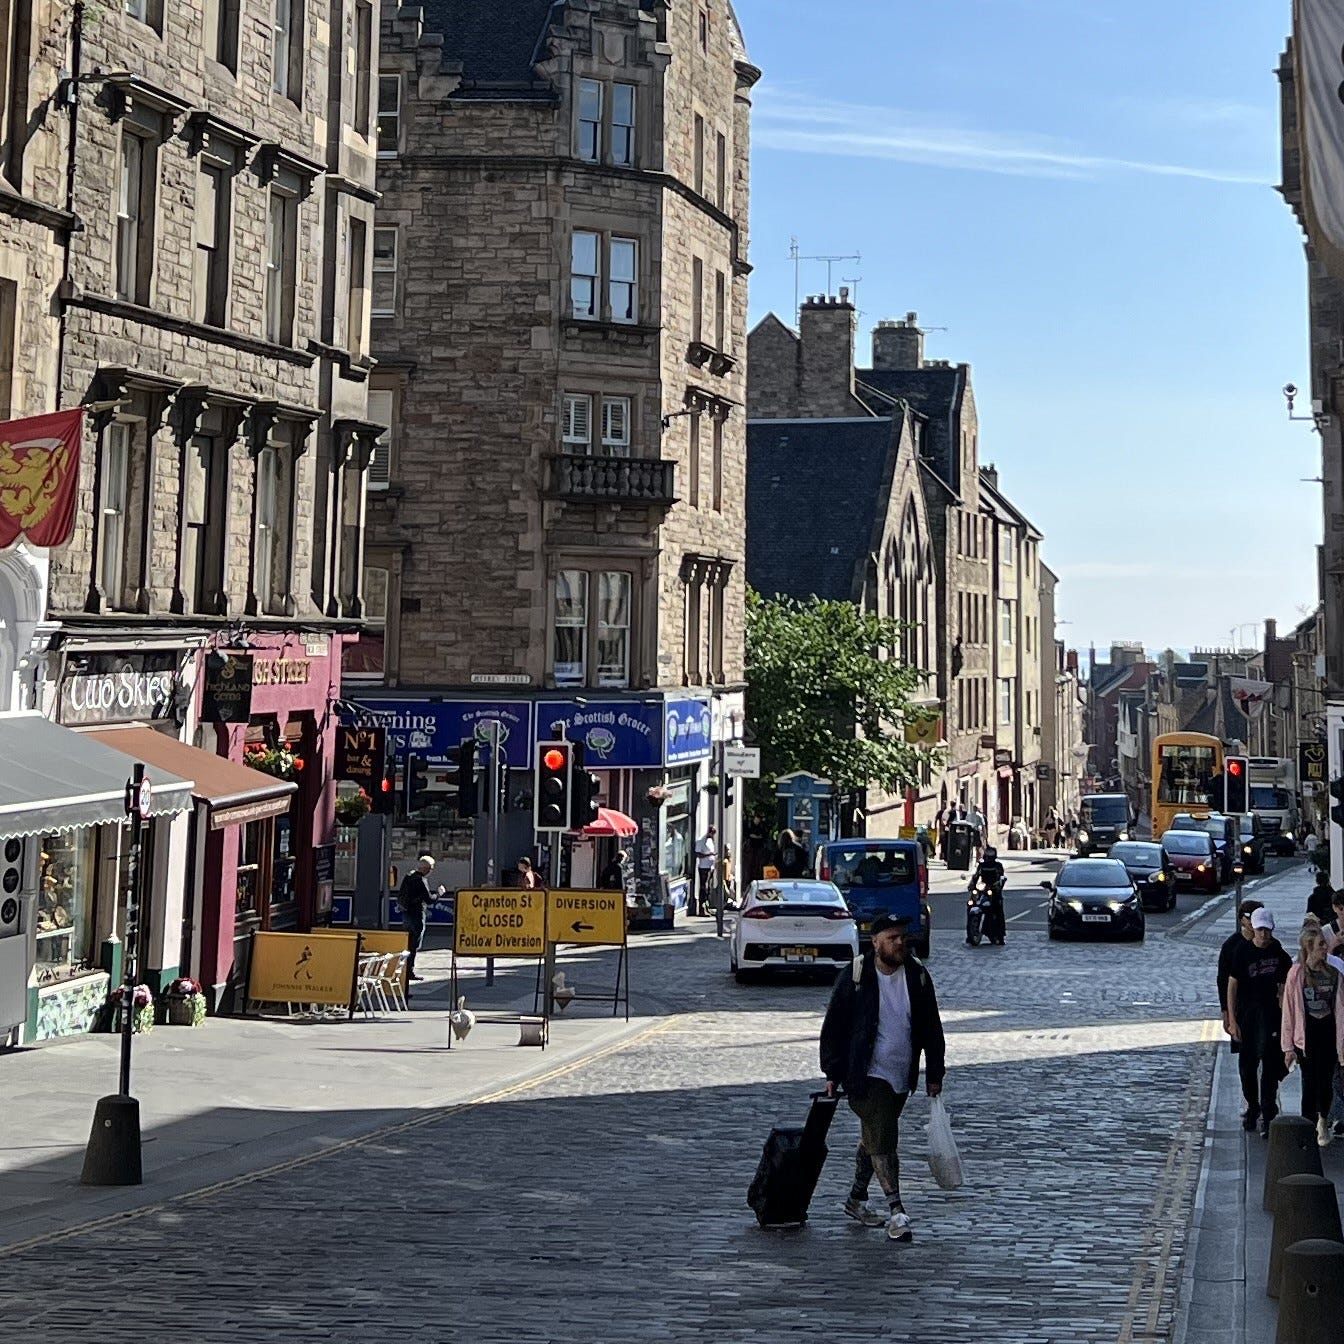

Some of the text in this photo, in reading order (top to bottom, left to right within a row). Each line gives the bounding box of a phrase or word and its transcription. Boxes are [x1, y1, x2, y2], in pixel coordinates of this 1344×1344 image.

[271, 658, 312, 684] STREET
[70, 663, 171, 711] Two Skies
[573, 713, 616, 726] Scottish
[617, 713, 652, 737] Grocer
[360, 755, 372, 766] &
[472, 894, 518, 911] Cranston
[521, 895, 533, 909] St
[556, 898, 616, 911] DIVERSION
[479, 914, 524, 928] CLOSED
[459, 934, 542, 948] Follow Diversion
[272, 983, 333, 993] JOHNNIE WALKER
